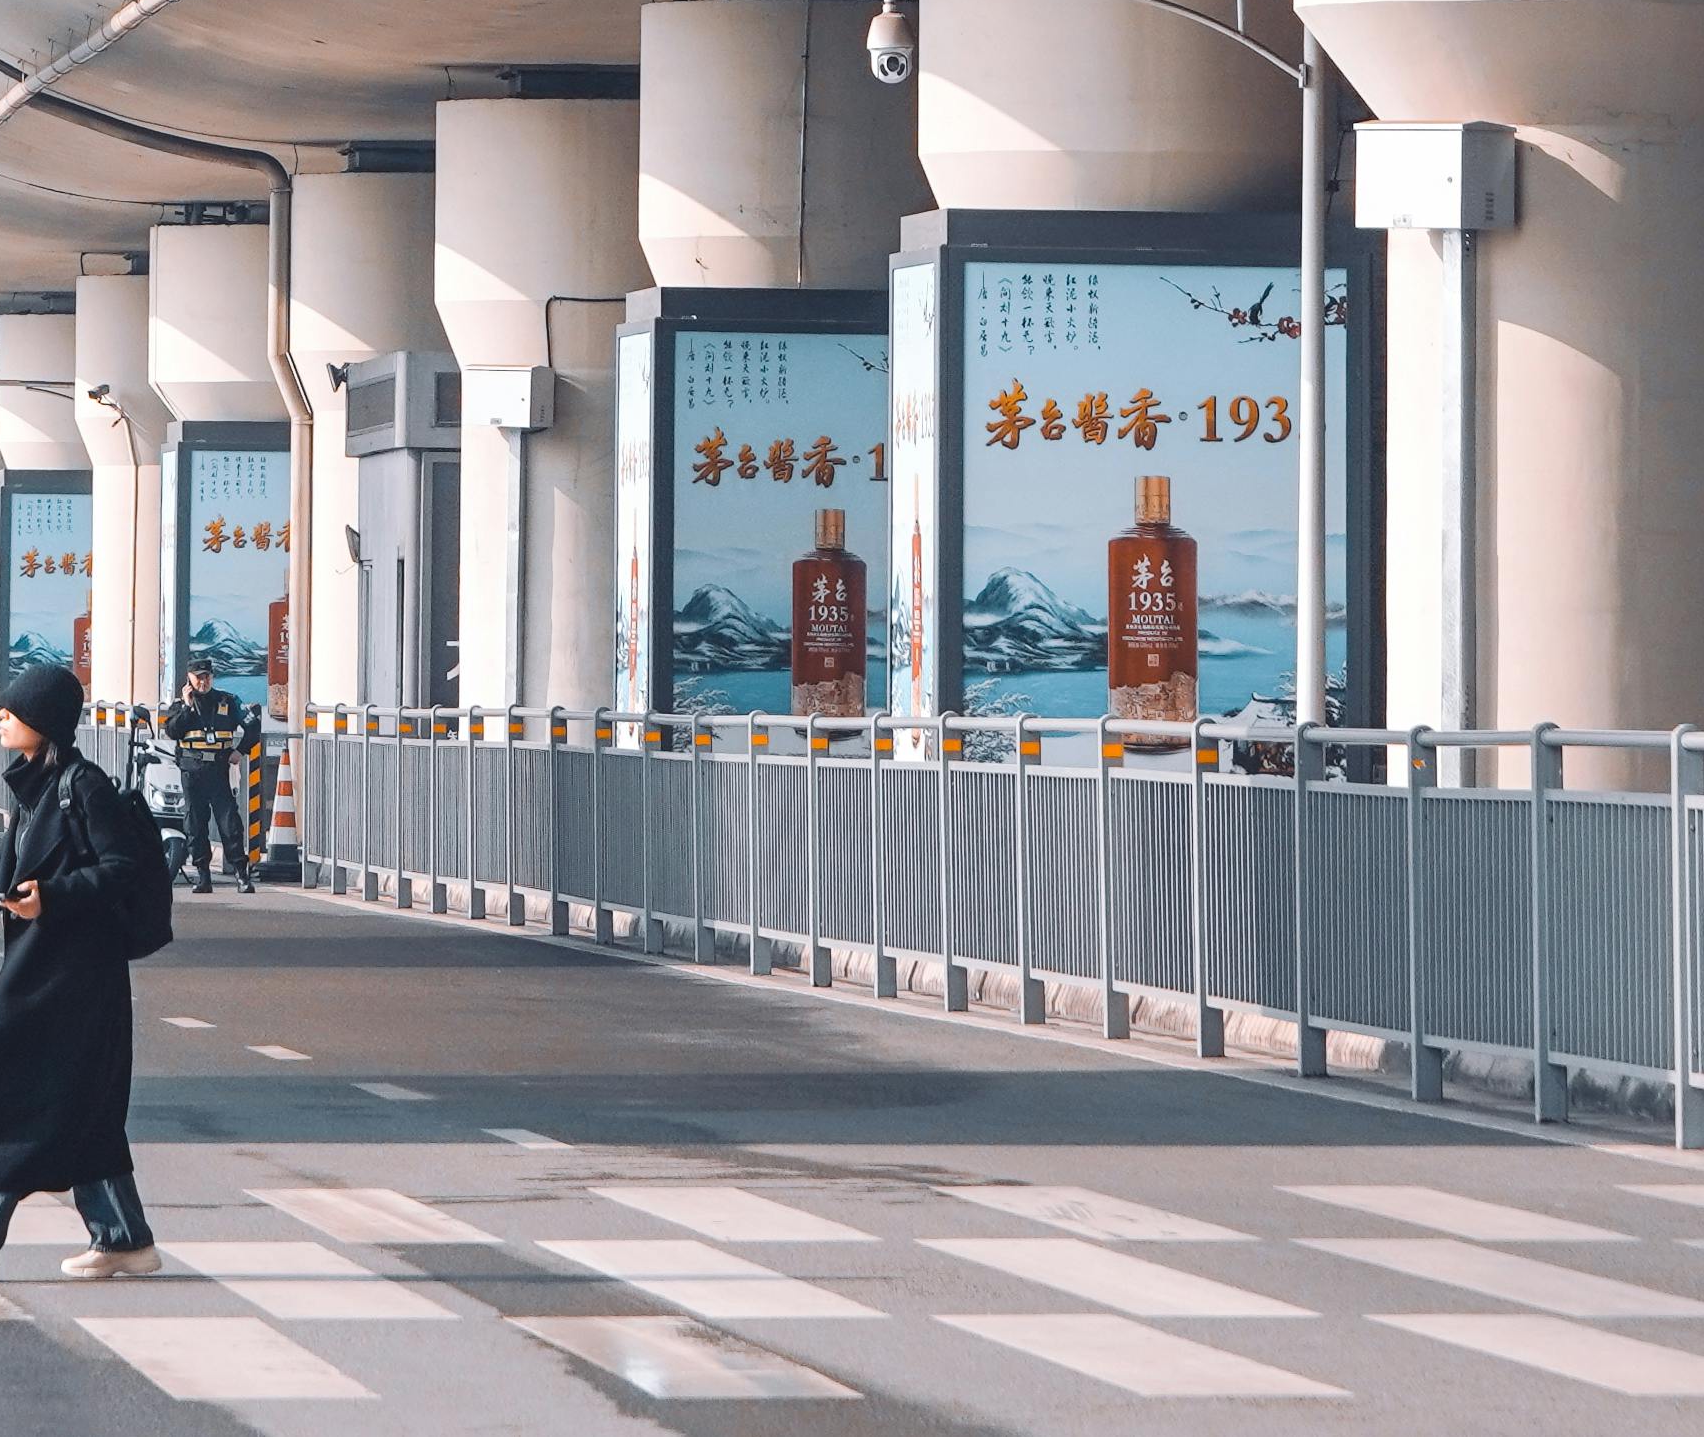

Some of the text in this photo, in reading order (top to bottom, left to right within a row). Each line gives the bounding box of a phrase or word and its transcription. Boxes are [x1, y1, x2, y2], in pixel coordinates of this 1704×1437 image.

[1128, 592, 1177, 611] 1935
[809, 605, 849, 622] 1935
[1132, 614, 1175, 624] MOUTAI
